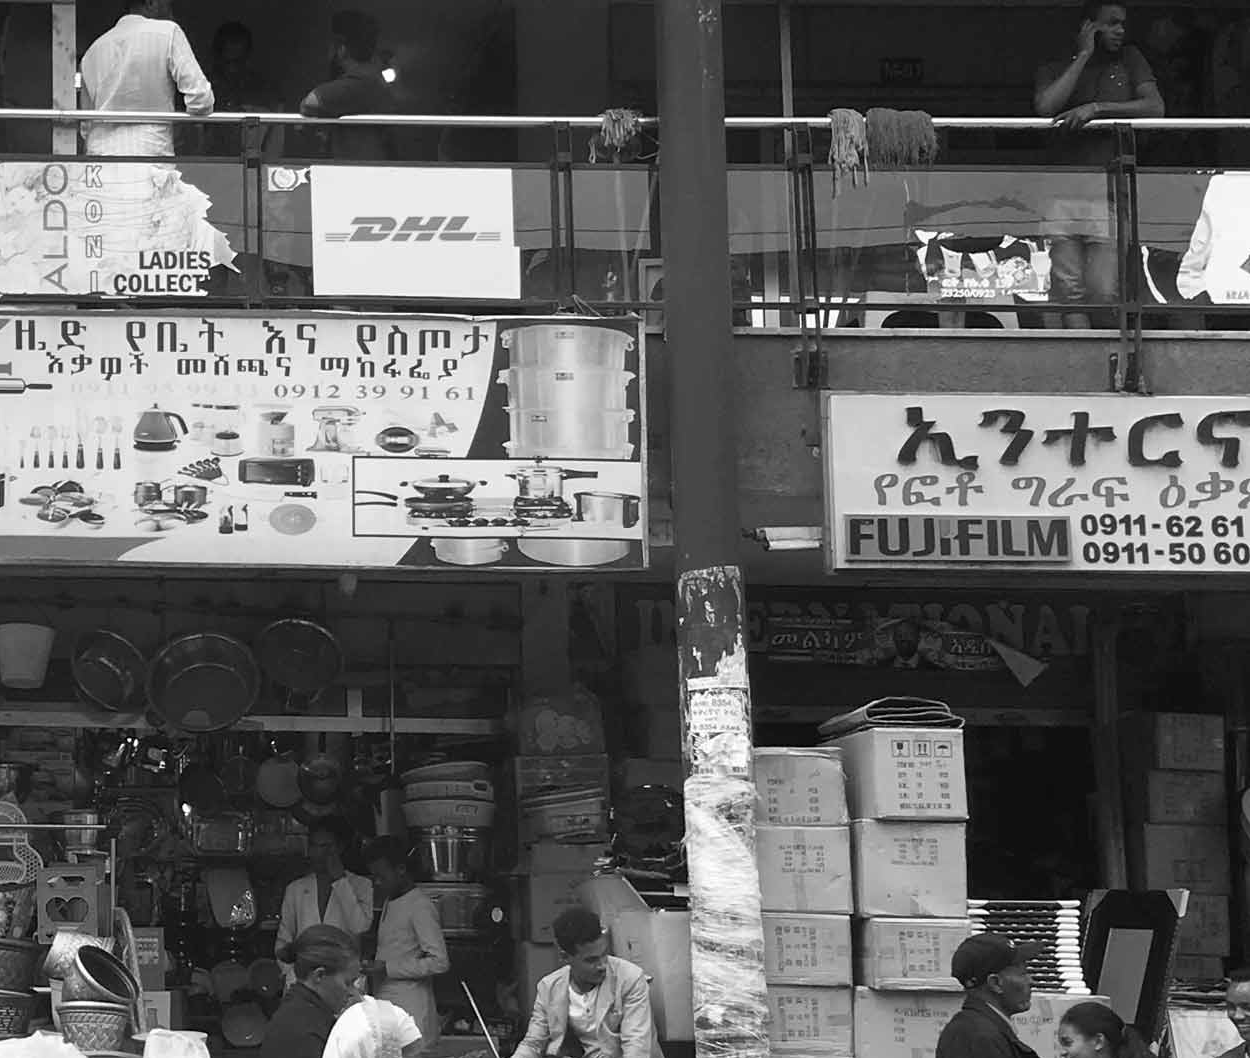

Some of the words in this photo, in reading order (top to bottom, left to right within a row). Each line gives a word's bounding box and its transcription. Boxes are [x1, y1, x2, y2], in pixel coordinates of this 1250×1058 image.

[350, 216, 478, 242] DHL
[139, 251, 211, 270] LADIES
[262, 321, 317, 354] እና
[357, 325, 488, 358] የስጦታ
[46, 352, 150, 381] እቃዎች
[274, 384, 341, 400] 0912
[356, 385, 387, 400] 39
[400, 385, 430, 401] 91
[445, 386, 475, 401] 61
[874, 472, 984, 506] የፎቶ
[1011, 477, 1130, 507] ግራፍ
[851, 517, 1069, 557] FUJIFILM
[1211, 515, 1244, 537] 61
[1213, 542, 1250, 565] 60
